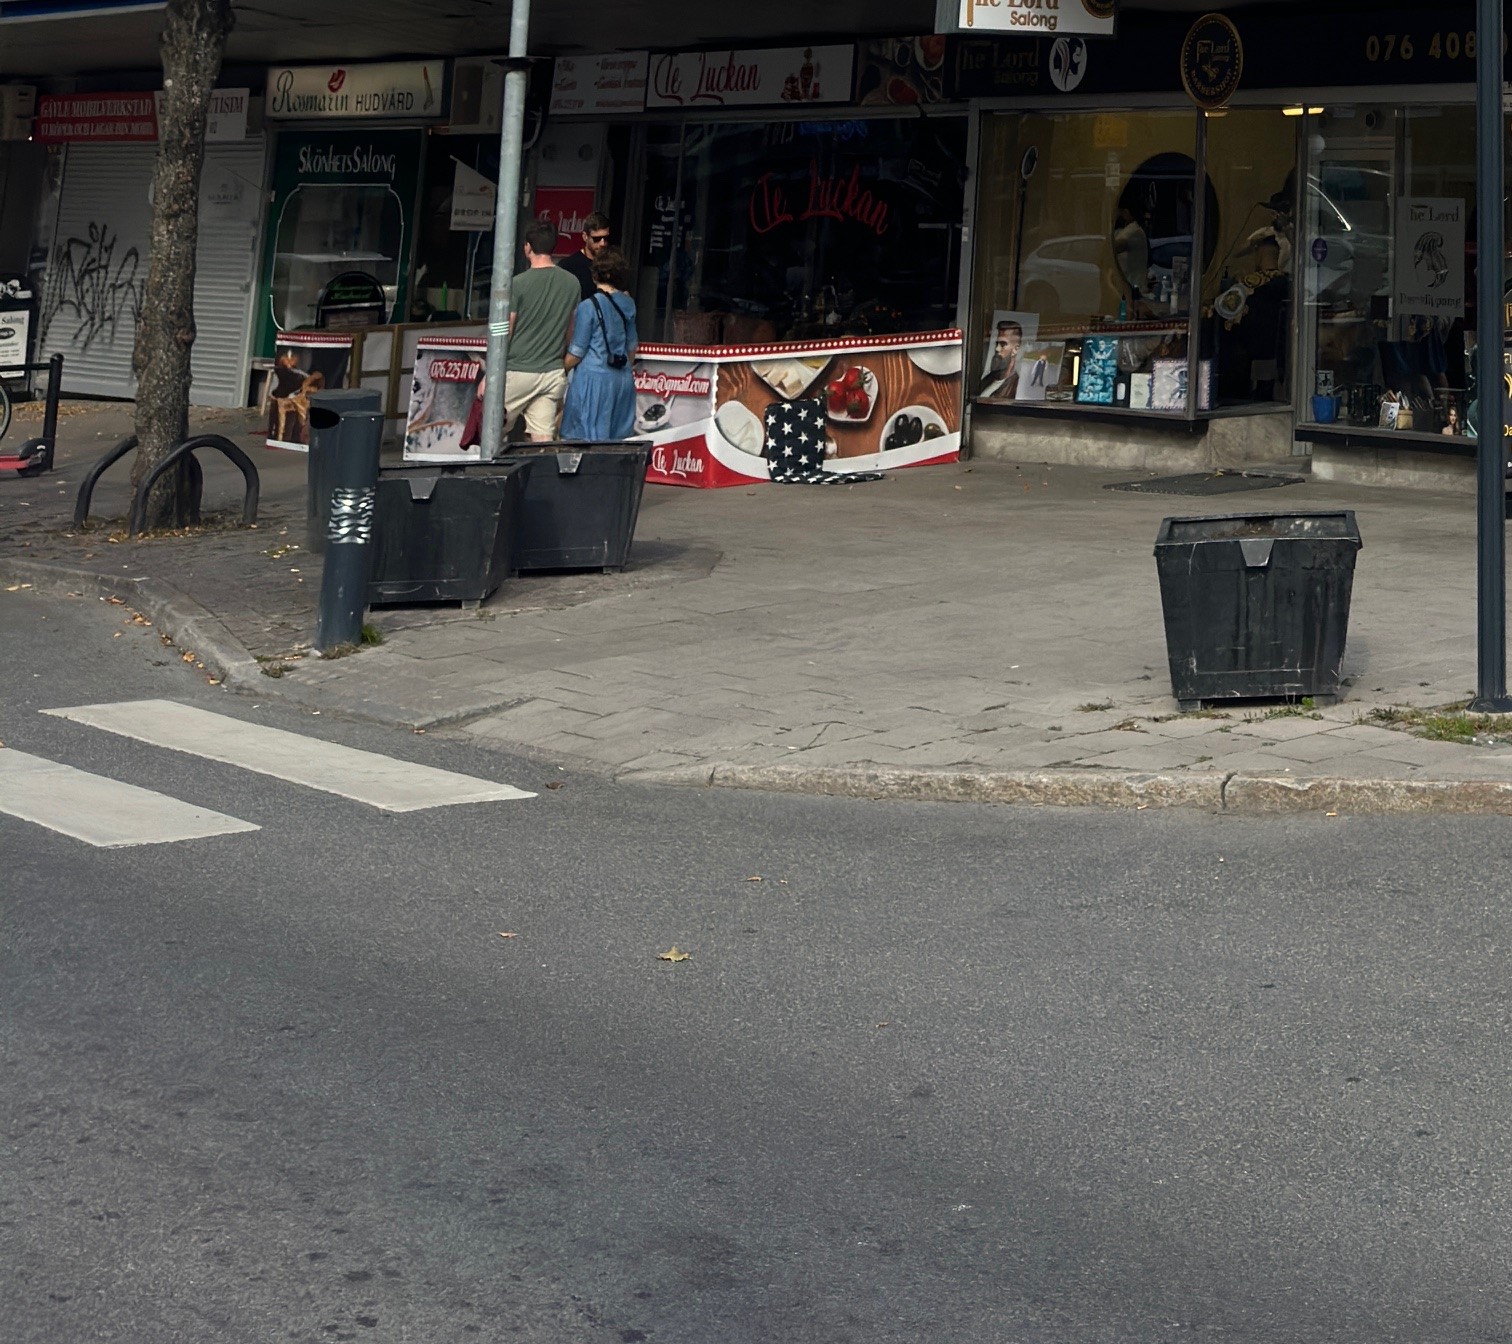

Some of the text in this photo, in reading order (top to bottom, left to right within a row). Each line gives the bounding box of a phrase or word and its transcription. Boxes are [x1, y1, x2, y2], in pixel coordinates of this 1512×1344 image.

[1010, 11, 1058, 30] Salong
[1365, 34, 1414, 61] 076
[1428, 30, 1476, 59] 408
[273, 70, 348, 112] Rosmarin
[356, 89, 414, 111] HUDVÅRD
[691, 47, 760, 105] Luckan
[800, 158, 890, 237] Luckan
[431, 362, 445, 379] 076
[446, 363, 461, 380] 225
[670, 448, 705, 478] Luckan
